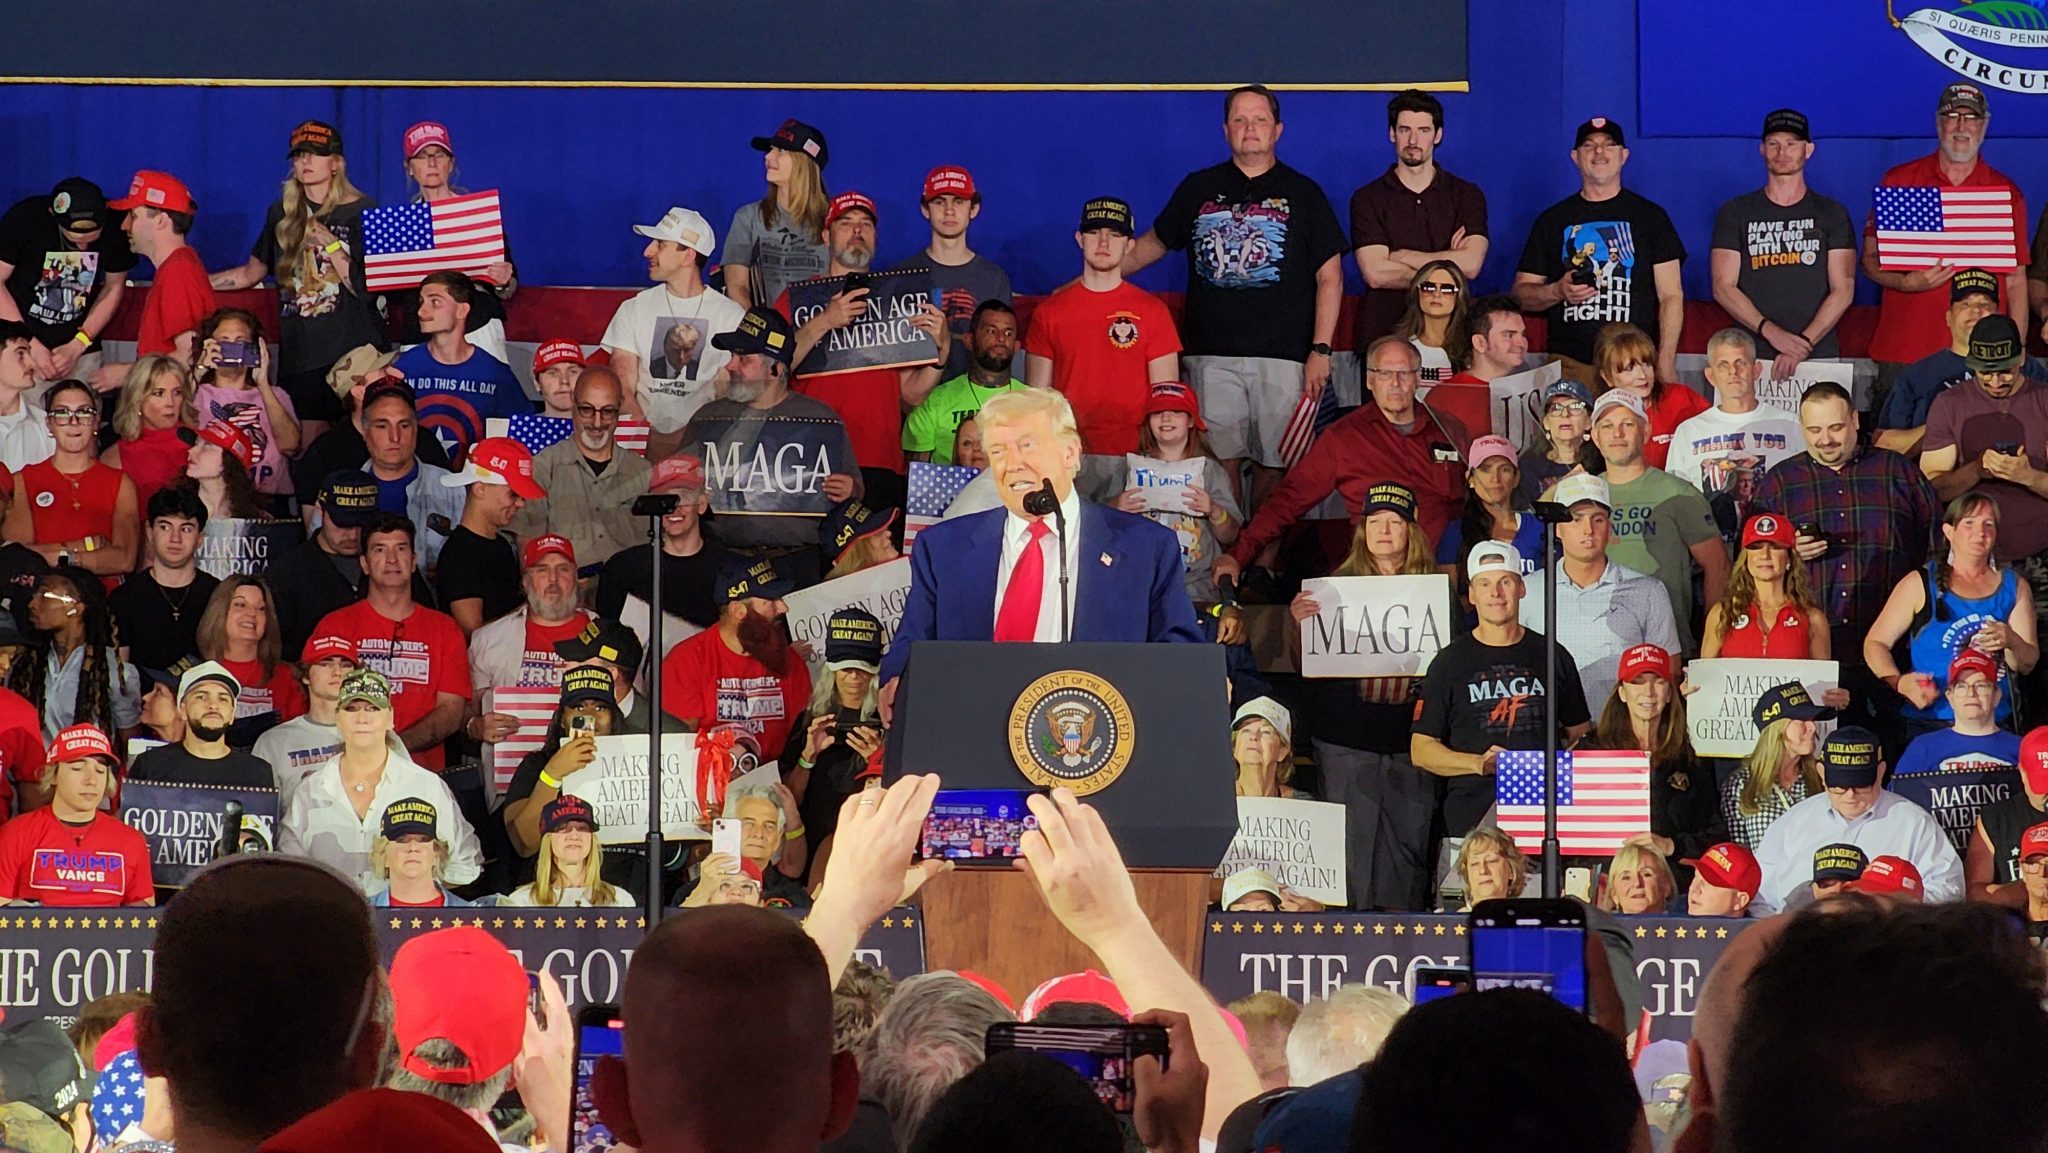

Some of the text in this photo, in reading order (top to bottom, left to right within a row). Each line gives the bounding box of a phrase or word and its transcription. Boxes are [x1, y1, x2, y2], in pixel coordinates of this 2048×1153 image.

[1928, 10, 1942, 24] SI
[1948, 18, 2002, 41] QUÆRIS
[1747, 218, 1814, 234] HAVE FUN
[1747, 229, 1804, 245] PLAYING
[1748, 239, 1820, 256] WITH YOUR
[1751, 251, 1801, 270] BITCOIN
[888, 291, 930, 319] AGE
[417, 377, 430, 389] DO
[433, 377, 457, 391] THIS
[459, 379, 478, 393] ALL
[479, 382, 497, 396] DAY
[1752, 432, 1786, 449] YOU
[703, 441, 832, 494] MAGA
[1628, 506, 1652, 521] GO
[1610, 519, 1657, 537] NDON
[1308, 603, 1444, 656] MAGA
[361, 638, 387, 649] AUTO
[386, 639, 425, 652] WRKERS
[523, 652, 549, 663] AUTO
[362, 658, 428, 680] RUMP
[518, 667, 564, 686] TRU
[1071, 676, 1083, 686] OF
[1085, 679, 1103, 691] THE
[1467, 678, 1546, 703] MAGA
[1724, 675, 1801, 697] MAKIN
[1012, 675, 1069, 731] PRESIDENT
[1103, 689, 1131, 742] UNITED
[1487, 694, 1531, 737] AF
[1015, 734, 1025, 753] THE
[600, 753, 680, 779] MAKNG
[1083, 753, 1127, 792] STATES
[1930, 782, 2011, 809] MAKING
[124, 807, 226, 841] GOLDEN
[592, 803, 641, 829] REAT
[1237, 816, 1312, 842] MAKING
[35, 852, 122, 873] TRUMP
[1229, 841, 1316, 866] AMERICA
[56, 868, 106, 883] VANCE
[1274, 866, 1338, 891] AGAIN!
[0, 948, 41, 1007] HE
[1240, 953, 1348, 1004] THE
[1636, 957, 1701, 1017] GE
[54, 1079, 79, 1110] 2024
